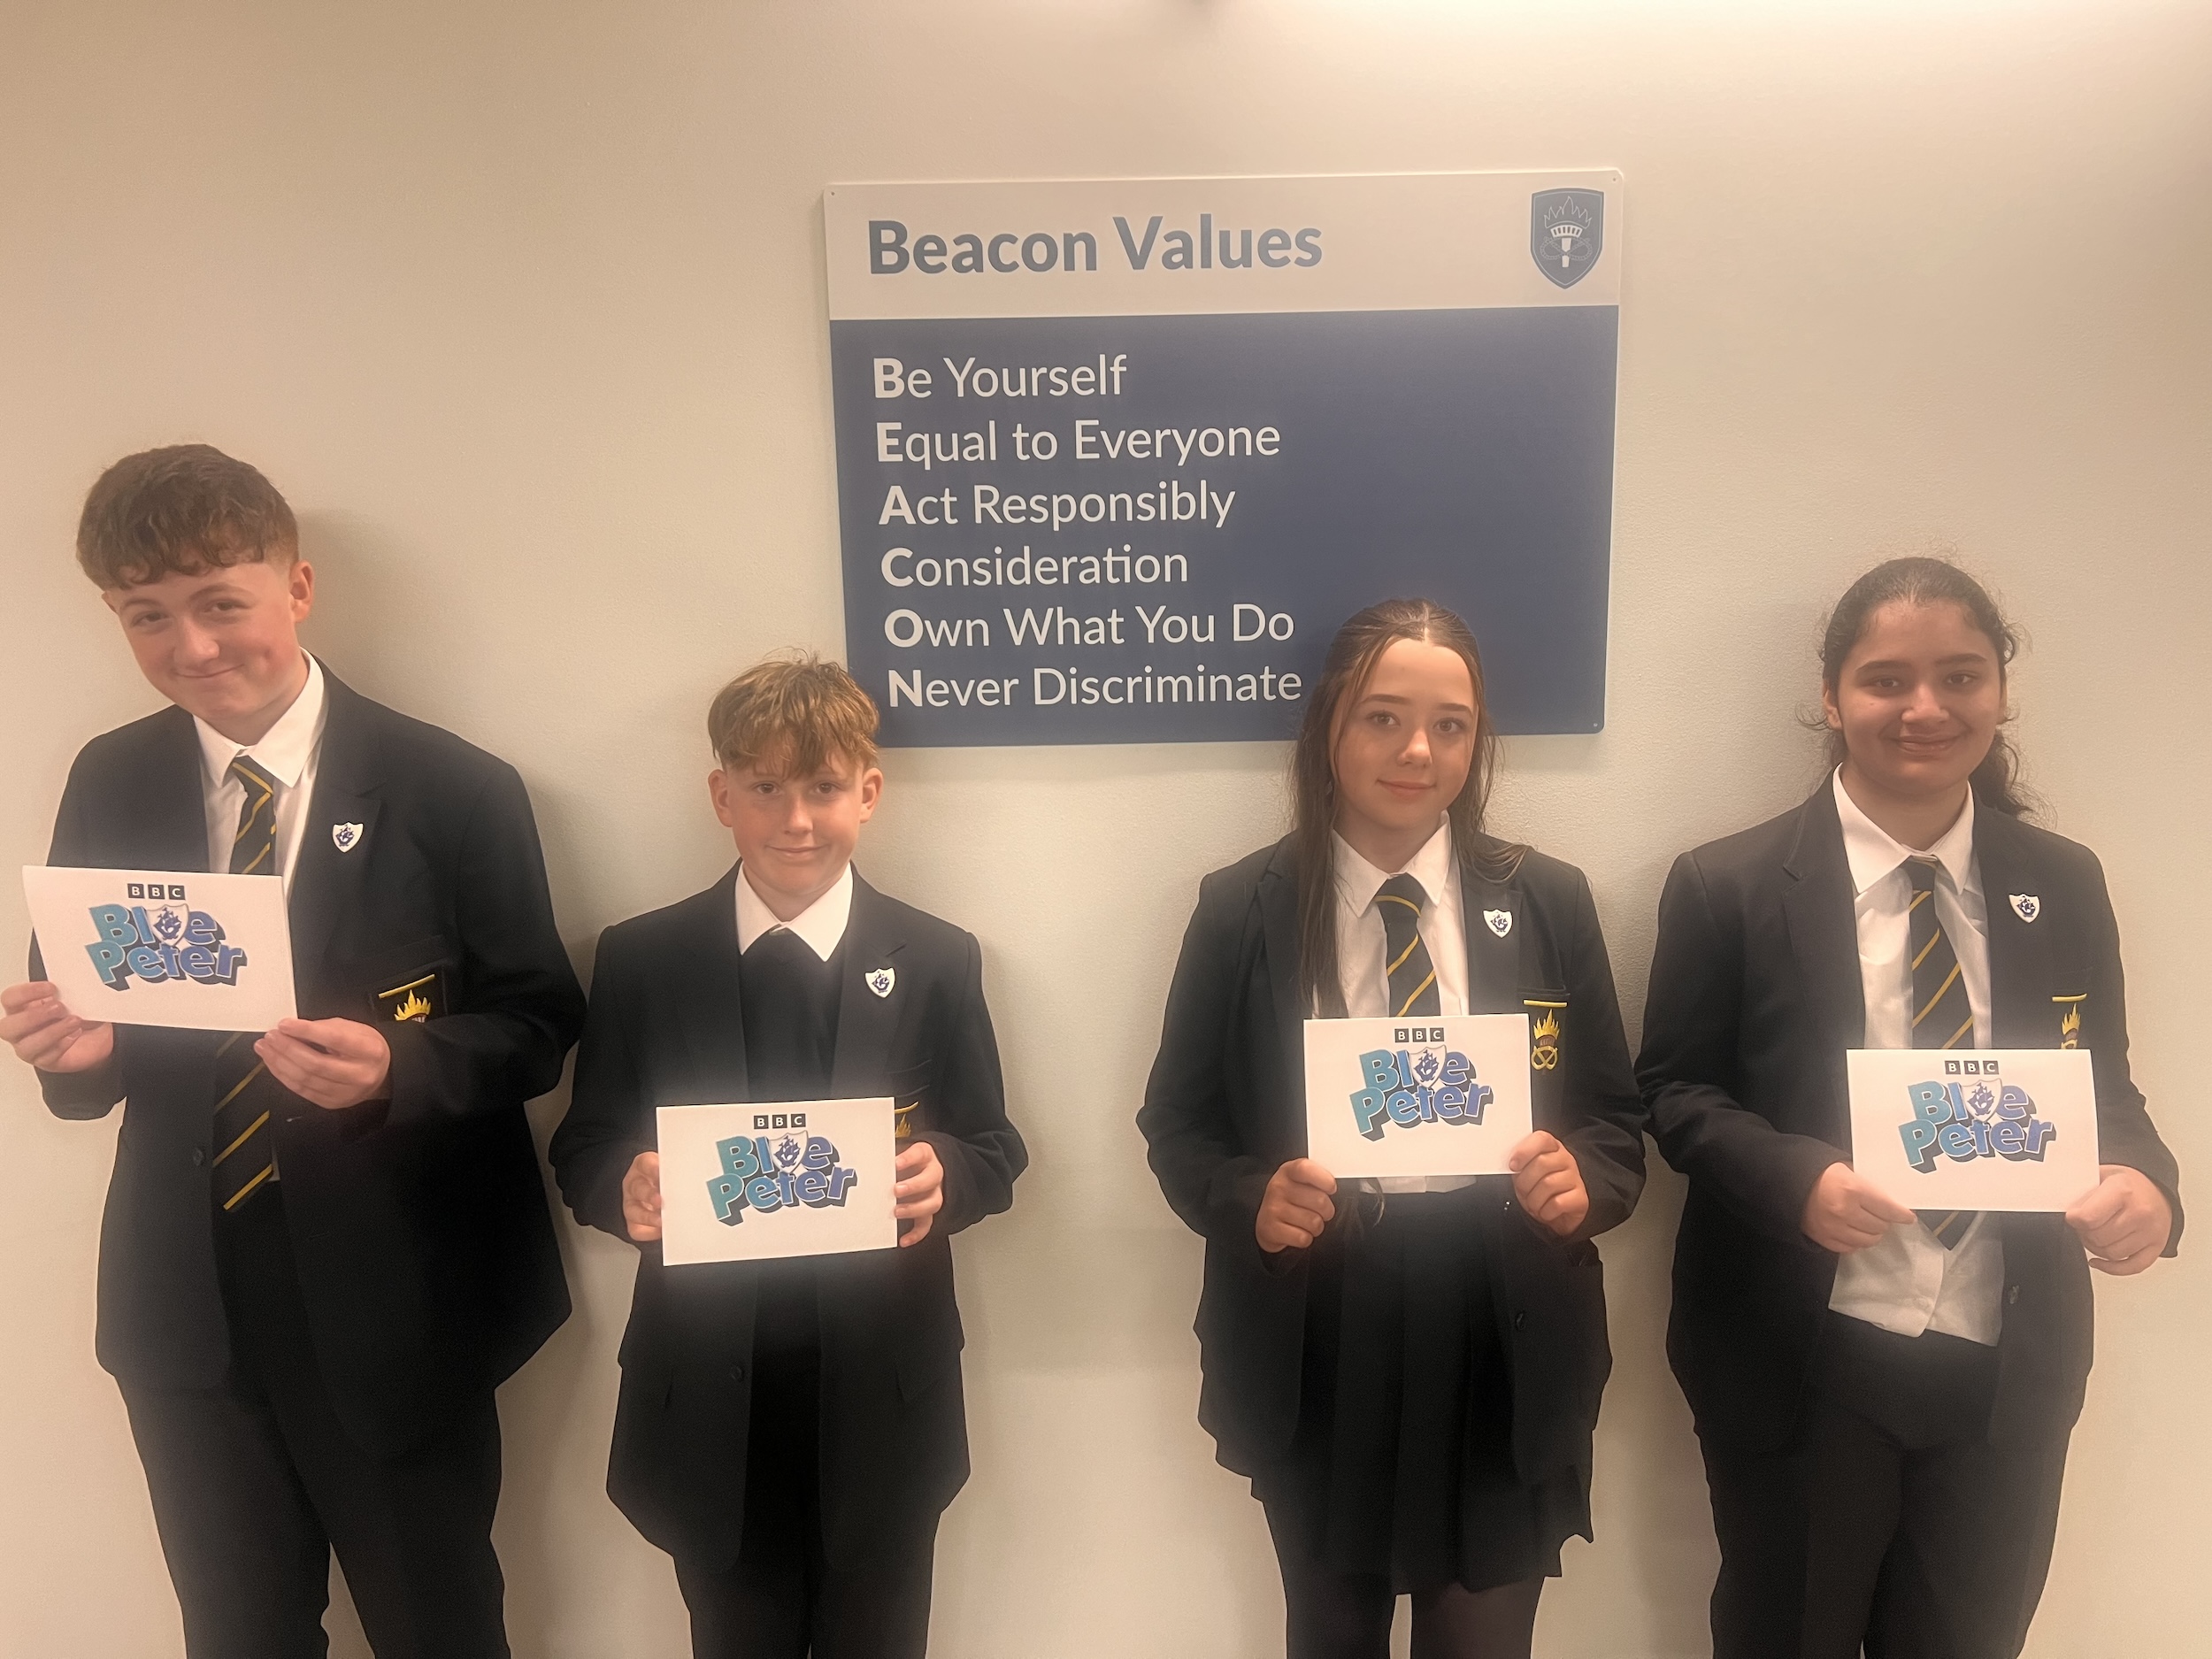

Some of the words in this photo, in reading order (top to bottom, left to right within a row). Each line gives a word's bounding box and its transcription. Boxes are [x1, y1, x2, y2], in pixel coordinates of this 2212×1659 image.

[869, 219, 1097, 275] Beacon
[1113, 213, 1323, 271] Values
[873, 357, 933, 399] Be
[943, 354, 1127, 397] Yourself
[876, 420, 996, 470] Equal
[1012, 424, 1058, 461] to
[1075, 419, 1280, 465] Everyone
[879, 485, 958, 526] Act
[974, 480, 1236, 531] Responsibly
[881, 544, 1187, 588] Consideration
[885, 609, 989, 648] Own
[1003, 607, 1125, 645] What
[1135, 605, 1215, 643] You
[1233, 604, 1294, 641] Do
[888, 669, 1019, 707] Never
[1034, 664, 1302, 705] Discriminate
[128, 884, 184, 899] BBC
[88, 903, 225, 949] Ble
[85, 941, 247, 990] Peter
[1395, 1028, 1443, 1041] BBC
[1359, 1045, 1477, 1092] Ble
[1946, 1061, 1998, 1073] BBC
[755, 1114, 804, 1128] BBC
[1350, 1084, 1494, 1141] Peter
[1908, 1079, 2036, 1125] Ble
[716, 1131, 839, 1179] Ble
[1899, 1118, 2056, 1173] Peter
[707, 1166, 857, 1225] Peter
